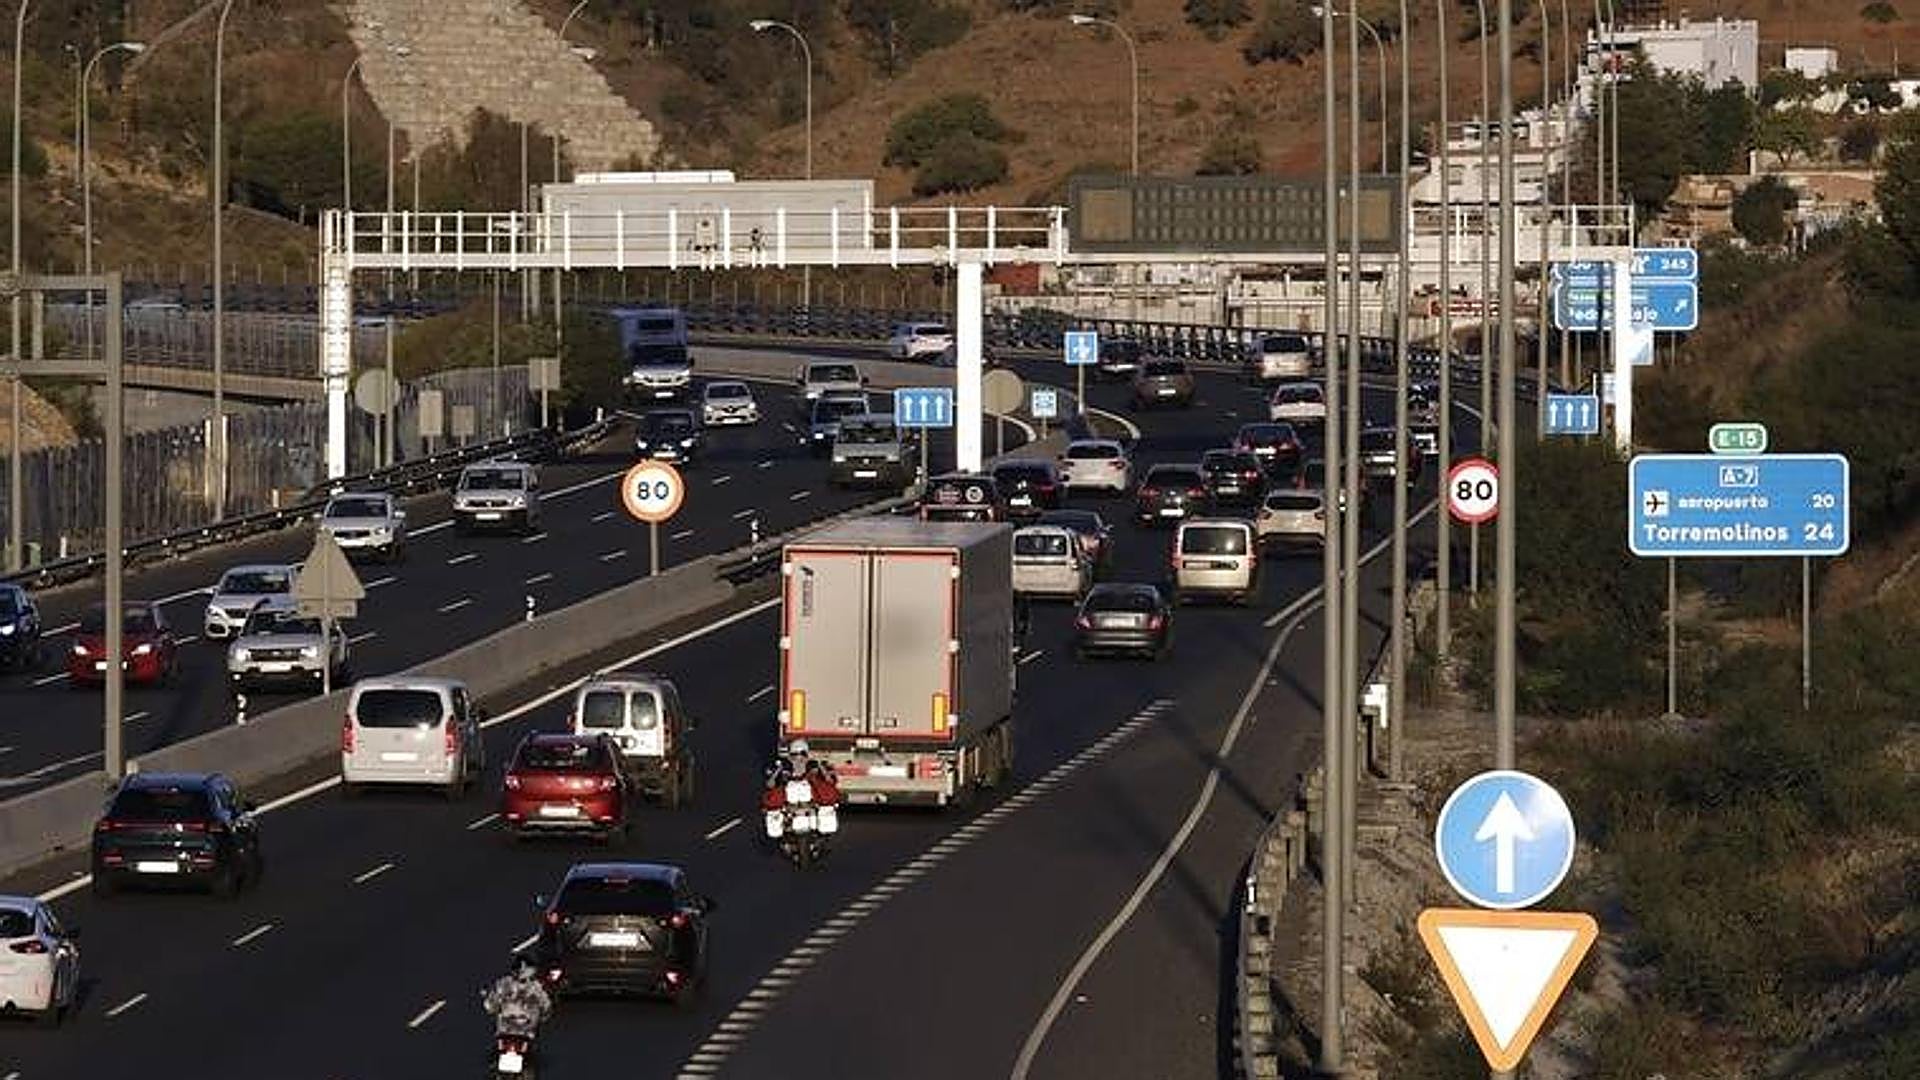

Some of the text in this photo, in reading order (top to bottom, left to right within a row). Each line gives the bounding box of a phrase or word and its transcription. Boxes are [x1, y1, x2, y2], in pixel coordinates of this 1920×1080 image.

[1719, 430, 1757, 447] E-15
[1724, 467, 1754, 483] A-7
[638, 481, 669, 500] 80
[1457, 480, 1492, 500] 80
[1678, 494, 1834, 512] aeropuerto 20
[1643, 522, 1835, 542] Torremolinos 24
